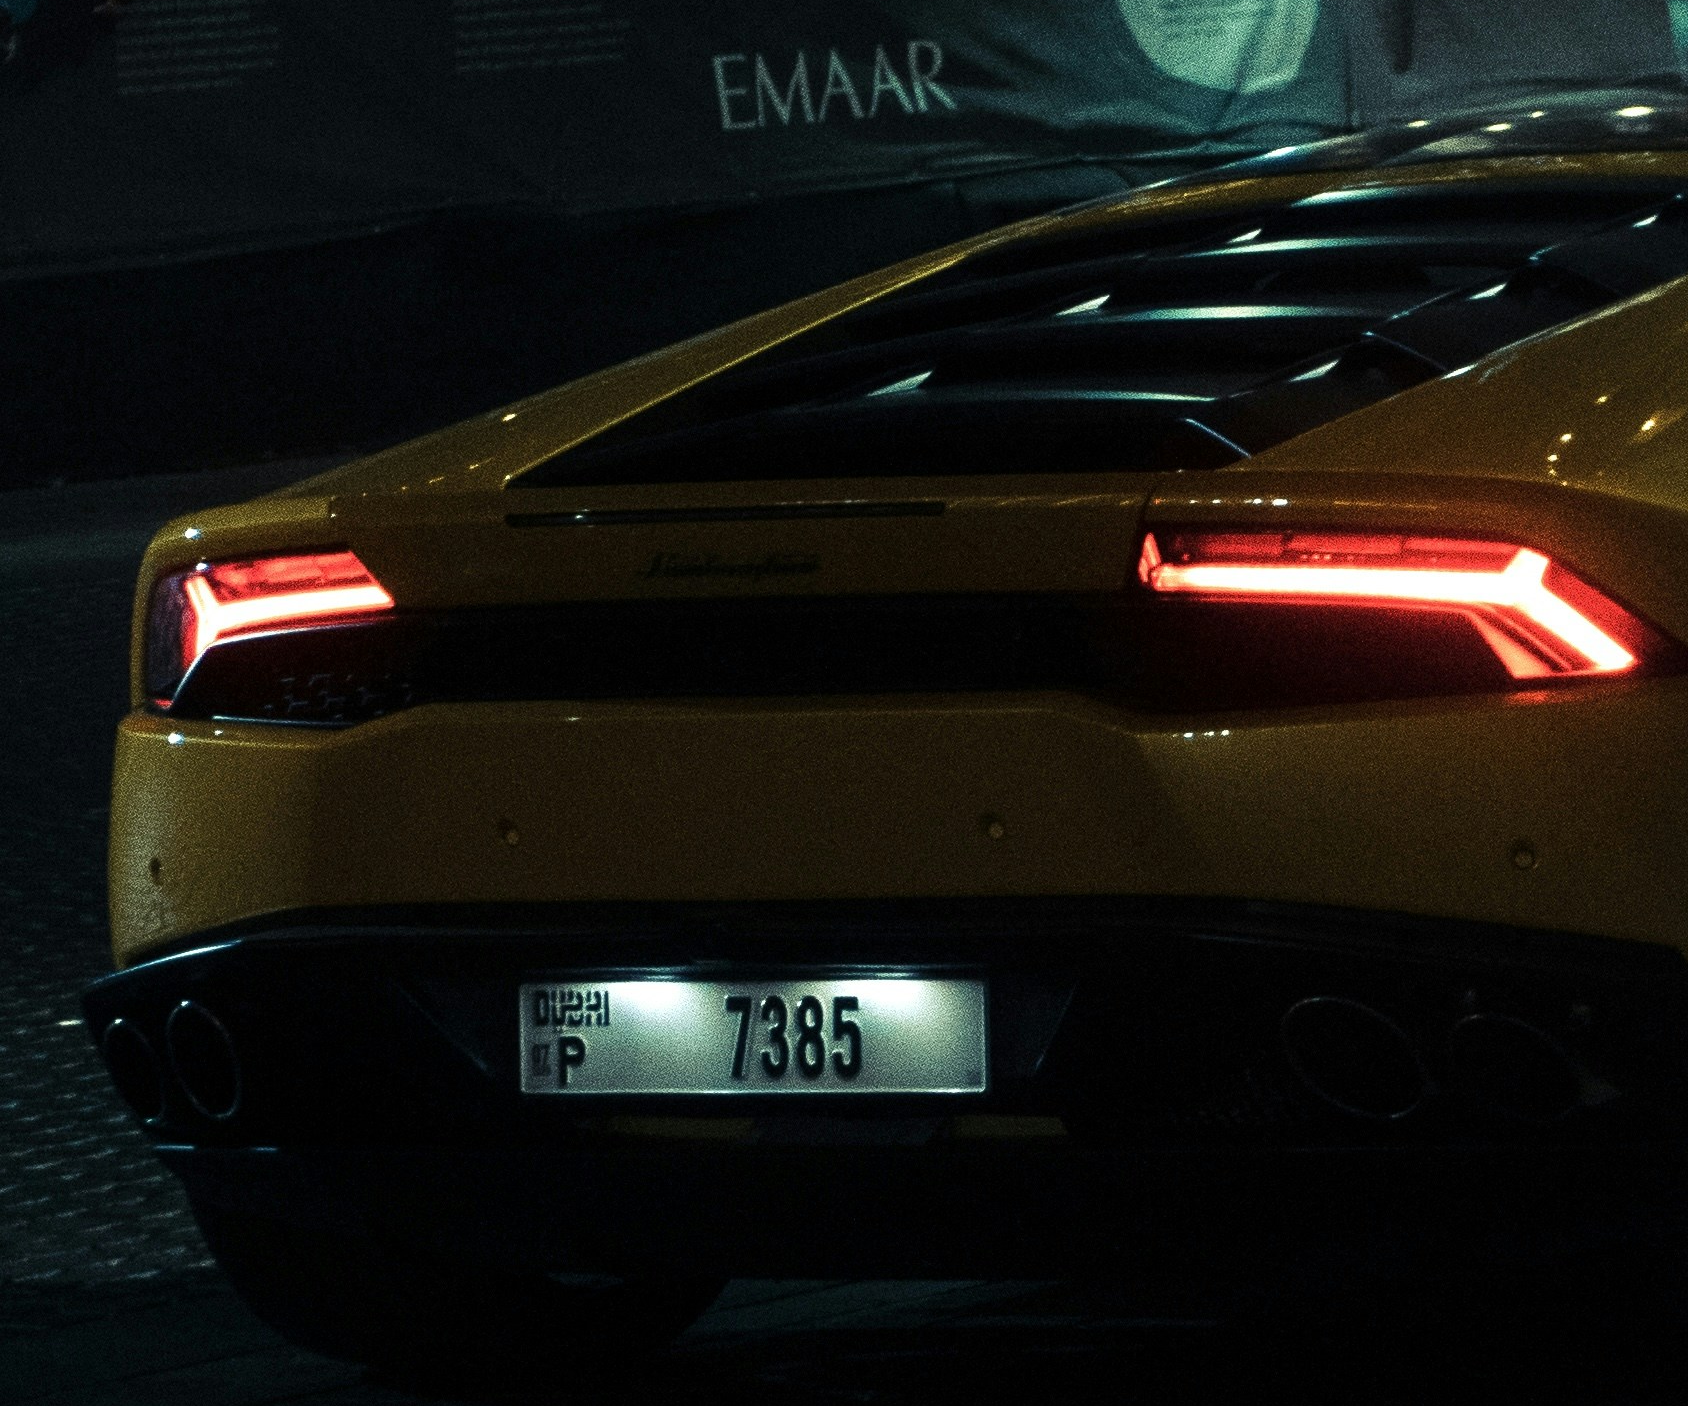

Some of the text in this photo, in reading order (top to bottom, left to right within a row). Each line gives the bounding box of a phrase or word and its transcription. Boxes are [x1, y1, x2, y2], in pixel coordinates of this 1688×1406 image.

[711, 40, 957, 130] EMAAR
[558, 1036, 585, 1089] P
[725, 995, 862, 1078] 7385
